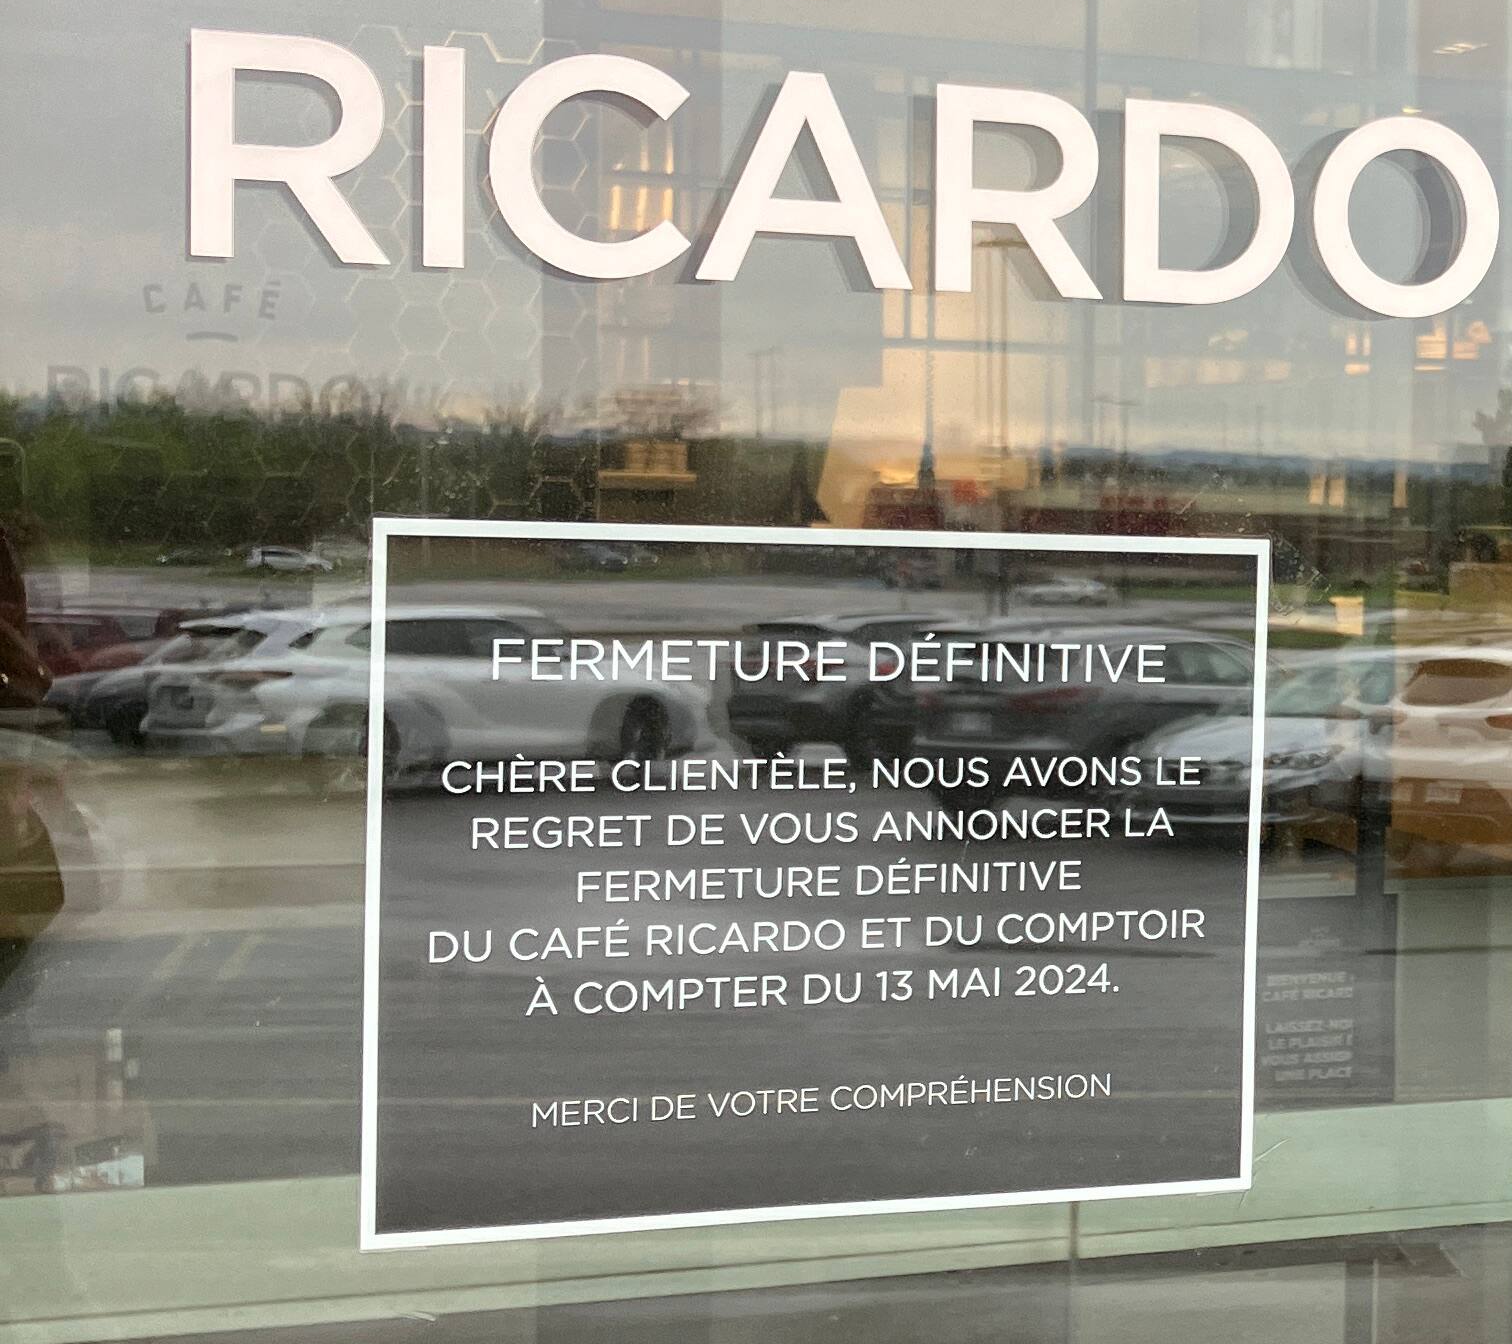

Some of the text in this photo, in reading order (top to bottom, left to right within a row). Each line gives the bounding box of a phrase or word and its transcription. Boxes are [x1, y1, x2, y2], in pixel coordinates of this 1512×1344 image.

[189, 27, 1501, 320] RICARDO
[143, 280, 281, 320] CAFÉ
[492, 633, 1167, 683] FERMETURE DÉFINITIVE
[441, 751, 1202, 794] CHÈRE CLIENTÈLE, NOUS AVONS LE
[471, 807, 1174, 850] REGRET DE VOUS ANNONCER LA
[576, 856, 1082, 903] FERMETURE DÉFINITIVE
[428, 908, 1205, 964] DU CAFÉ RICARDO ET DU COMPTOIR
[525, 962, 1120, 1016] À COMPTER DU 13 MAI 2024.
[532, 1072, 1111, 1128] MERCI DE VOTRE COMPRÉHENSION
